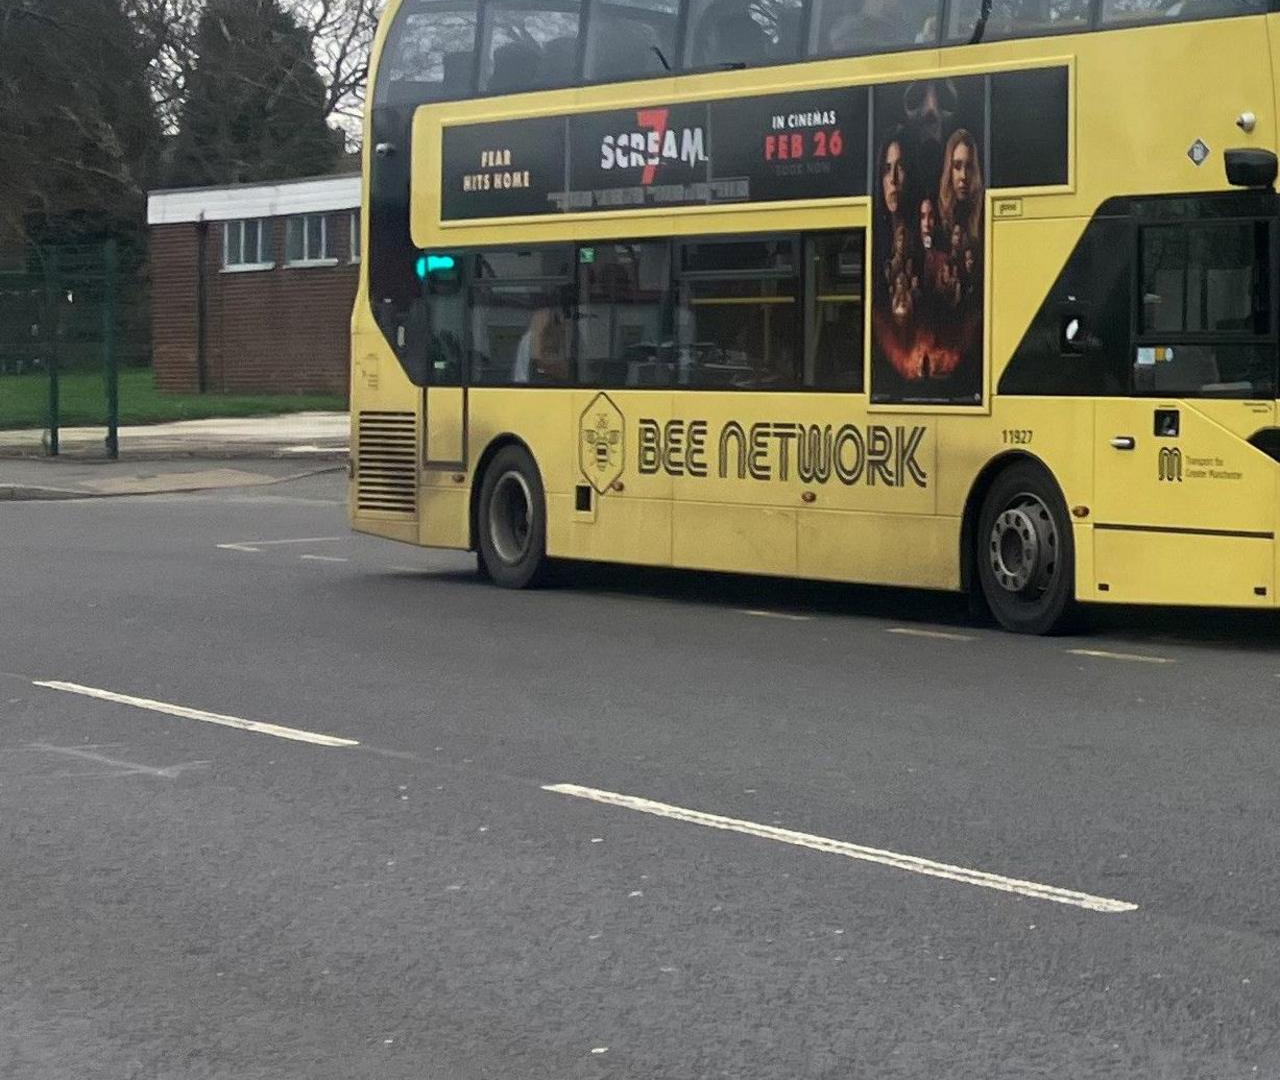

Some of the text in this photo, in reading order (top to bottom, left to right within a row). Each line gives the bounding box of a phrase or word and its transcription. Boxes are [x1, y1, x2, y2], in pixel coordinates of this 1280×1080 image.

[772, 111, 836, 129] IN CINEMAS
[601, 127, 709, 170] SCREAM
[764, 131, 843, 160] FEB 26
[481, 150, 512, 169] FEAR
[462, 170, 530, 192] HITS HOME
[1001, 429, 1034, 444] 11927
[639, 419, 928, 489] BEE NETWORK
